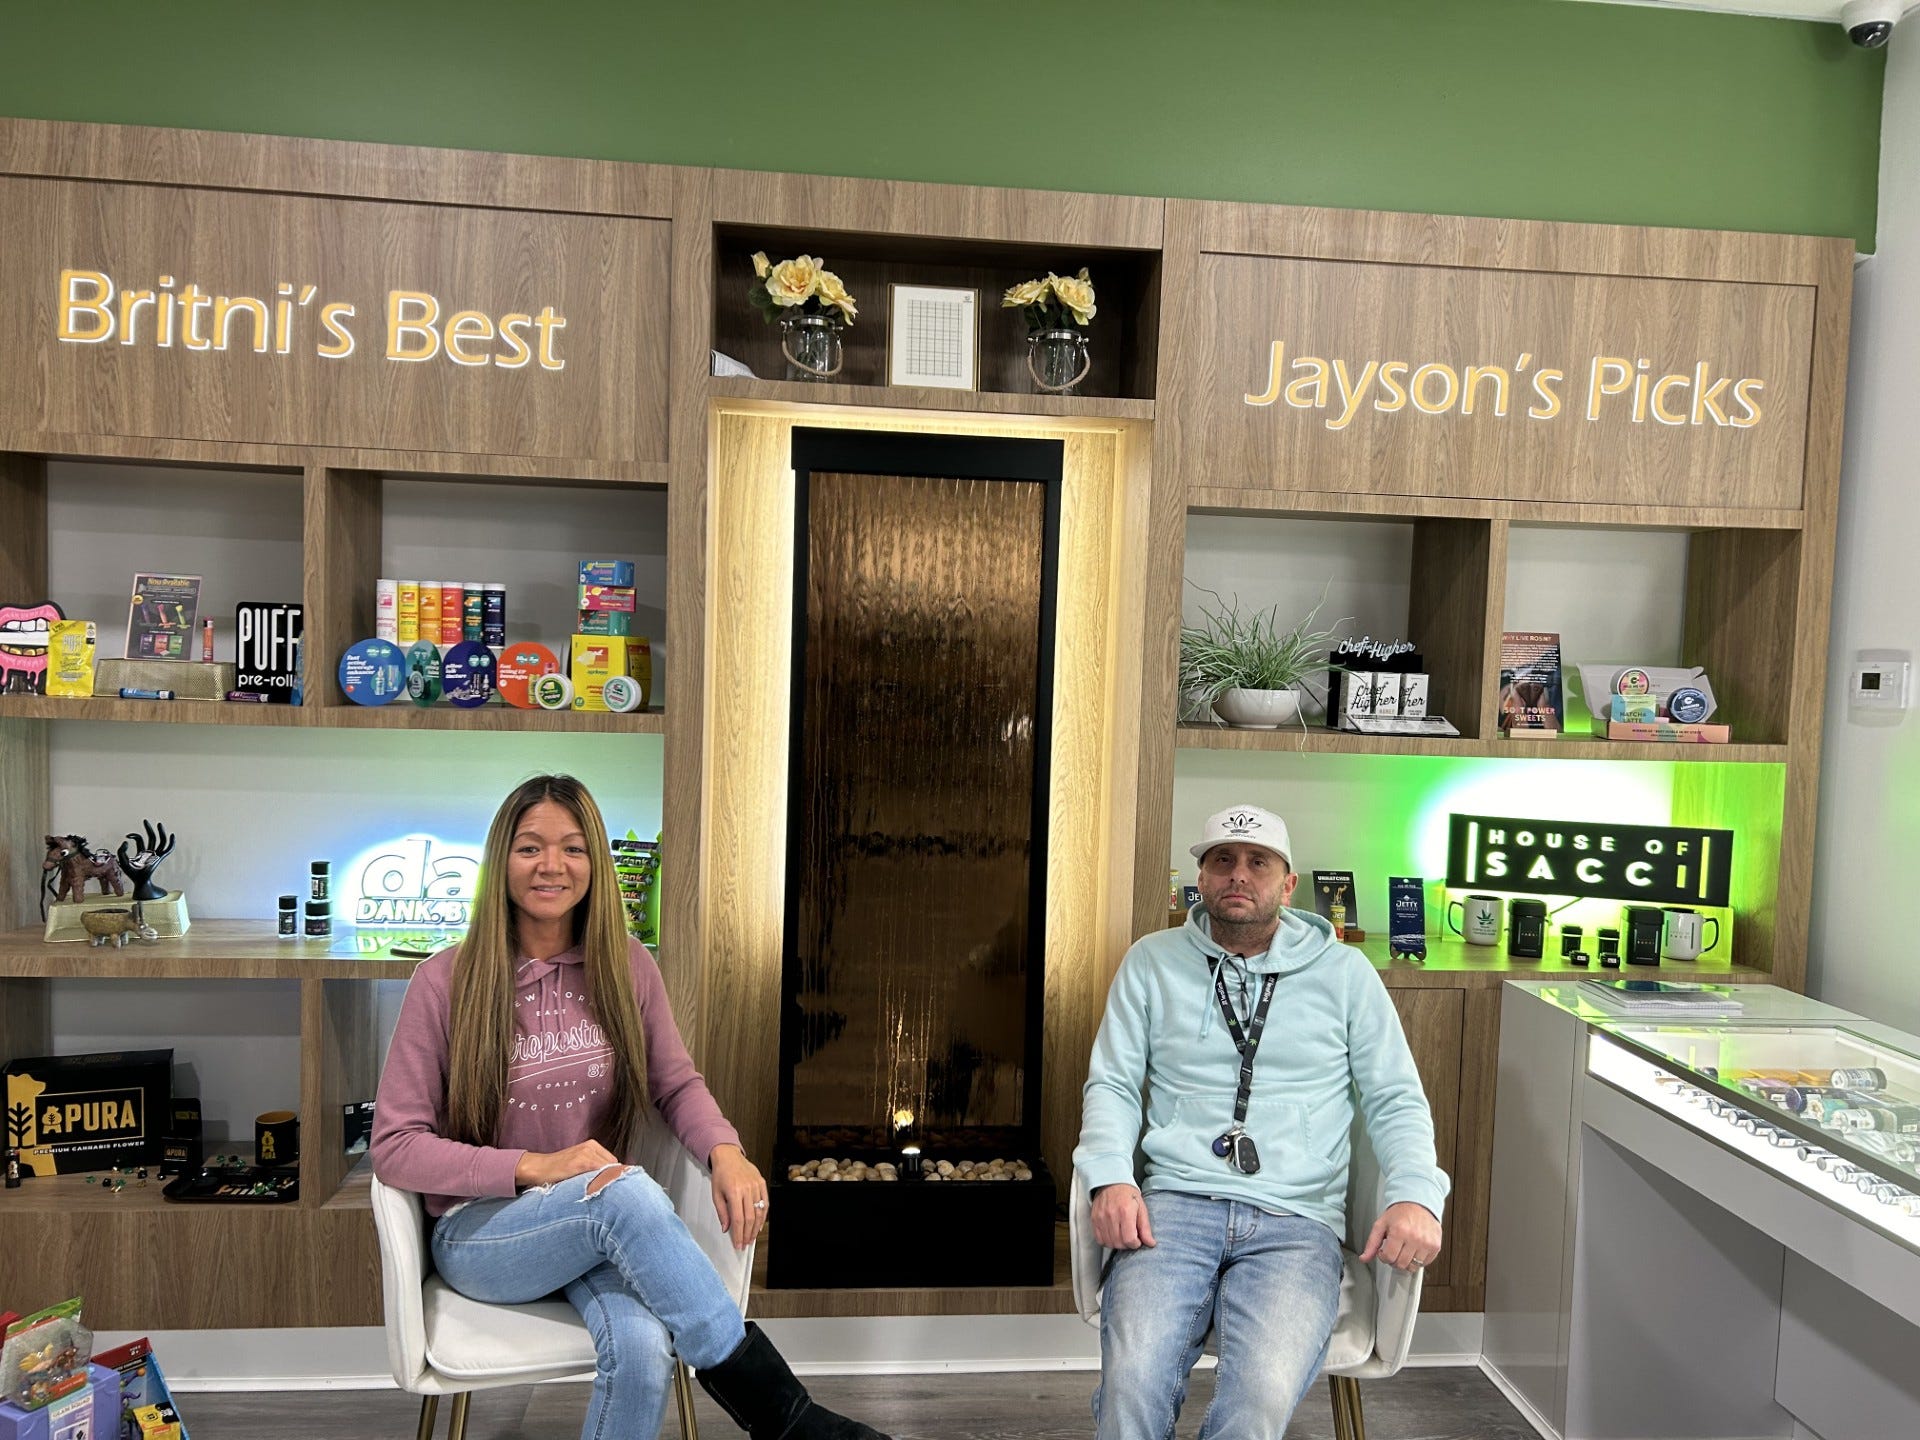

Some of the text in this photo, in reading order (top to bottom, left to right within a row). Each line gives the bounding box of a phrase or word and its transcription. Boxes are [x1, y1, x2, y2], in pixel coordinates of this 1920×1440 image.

[57, 268, 567, 371] Britni's Best
[1243, 339, 1765, 431] Jayson's Picks
[239, 607, 302, 672] PUFF
[1338, 636, 1370, 658] Chef
[1514, 714, 1546, 722] SWEETS
[1488, 828, 1689, 856] HOUSE OF
[1485, 850, 1687, 889] SACCI
[1396, 899, 1418, 908] JETTY
[514, 993, 535, 1008] EW
[536, 1008, 567, 1017] EAST
[587, 1062, 610, 1078] 87
[536, 1081, 577, 1090] COAST
[33, 1140, 145, 1156] PREMIUM CANNABIS FLOWER
